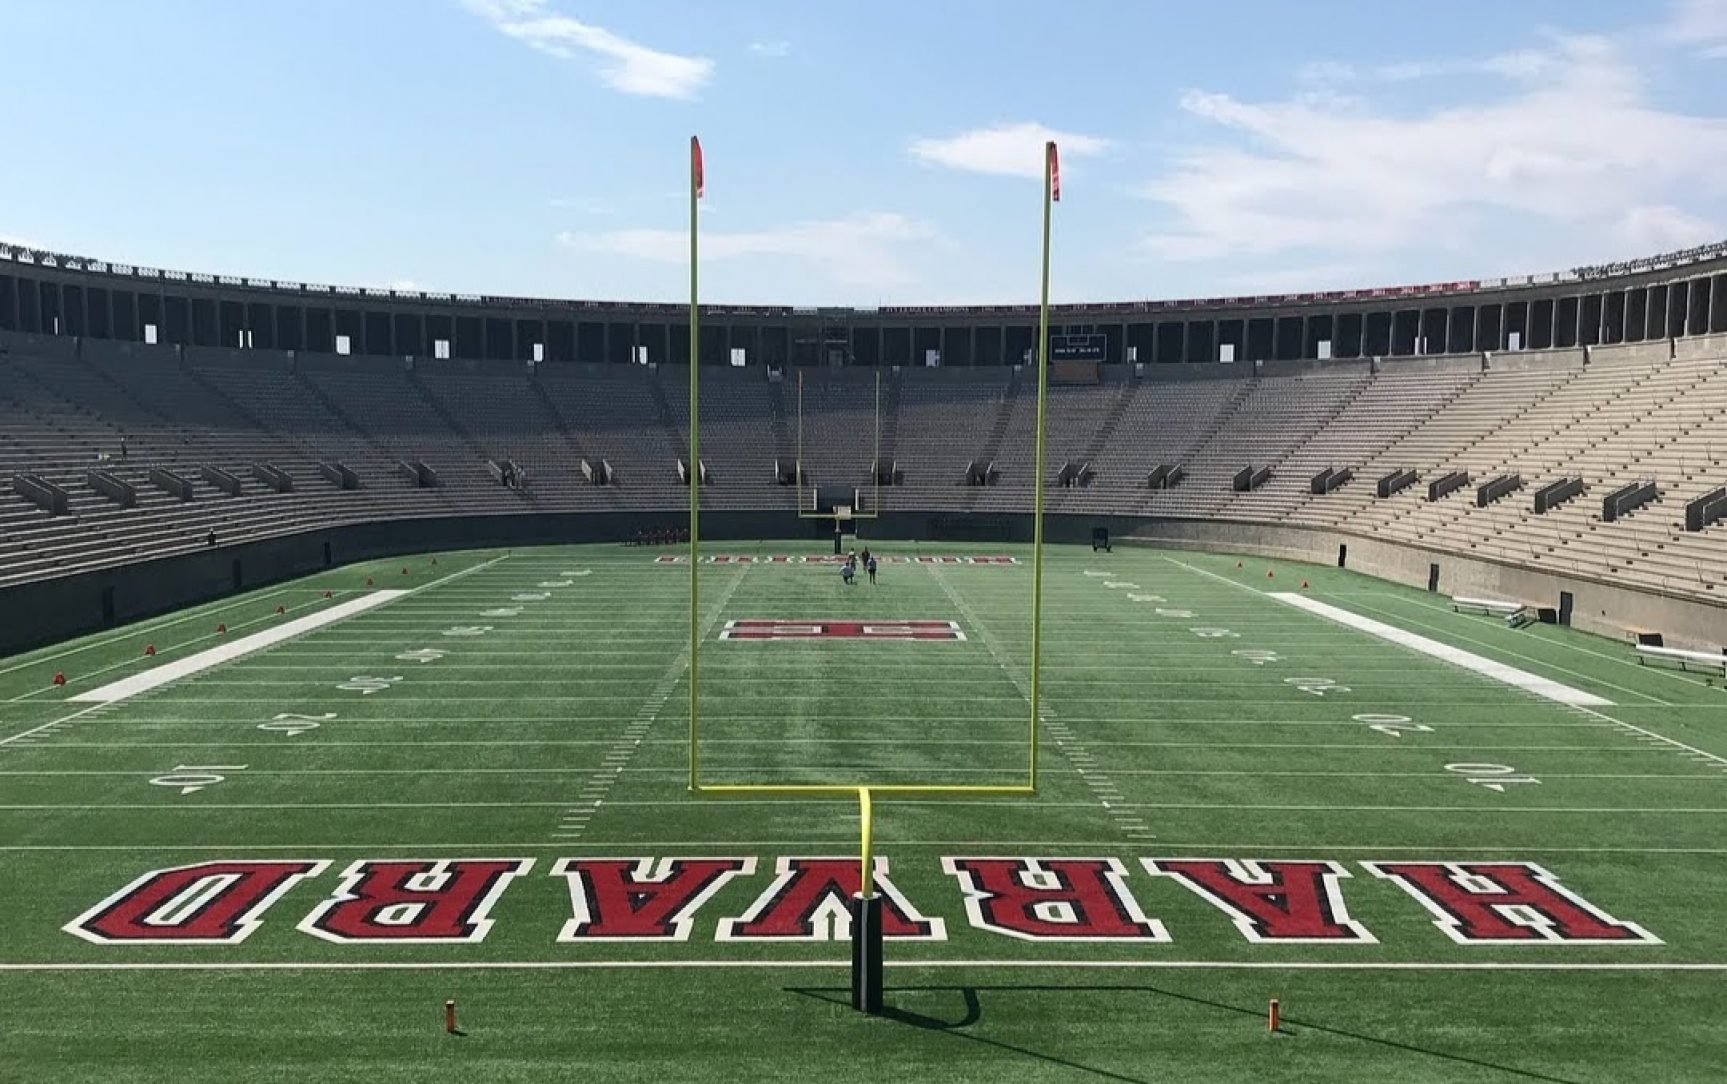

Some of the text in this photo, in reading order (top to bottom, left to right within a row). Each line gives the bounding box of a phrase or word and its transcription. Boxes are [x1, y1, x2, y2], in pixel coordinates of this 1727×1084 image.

[256, 713, 338, 731] 20
[1352, 713, 1435, 732] 20
[149, 764, 248, 786] 10
[1443, 763, 1543, 785] 10
[61, 857, 1666, 945] HARVARD
